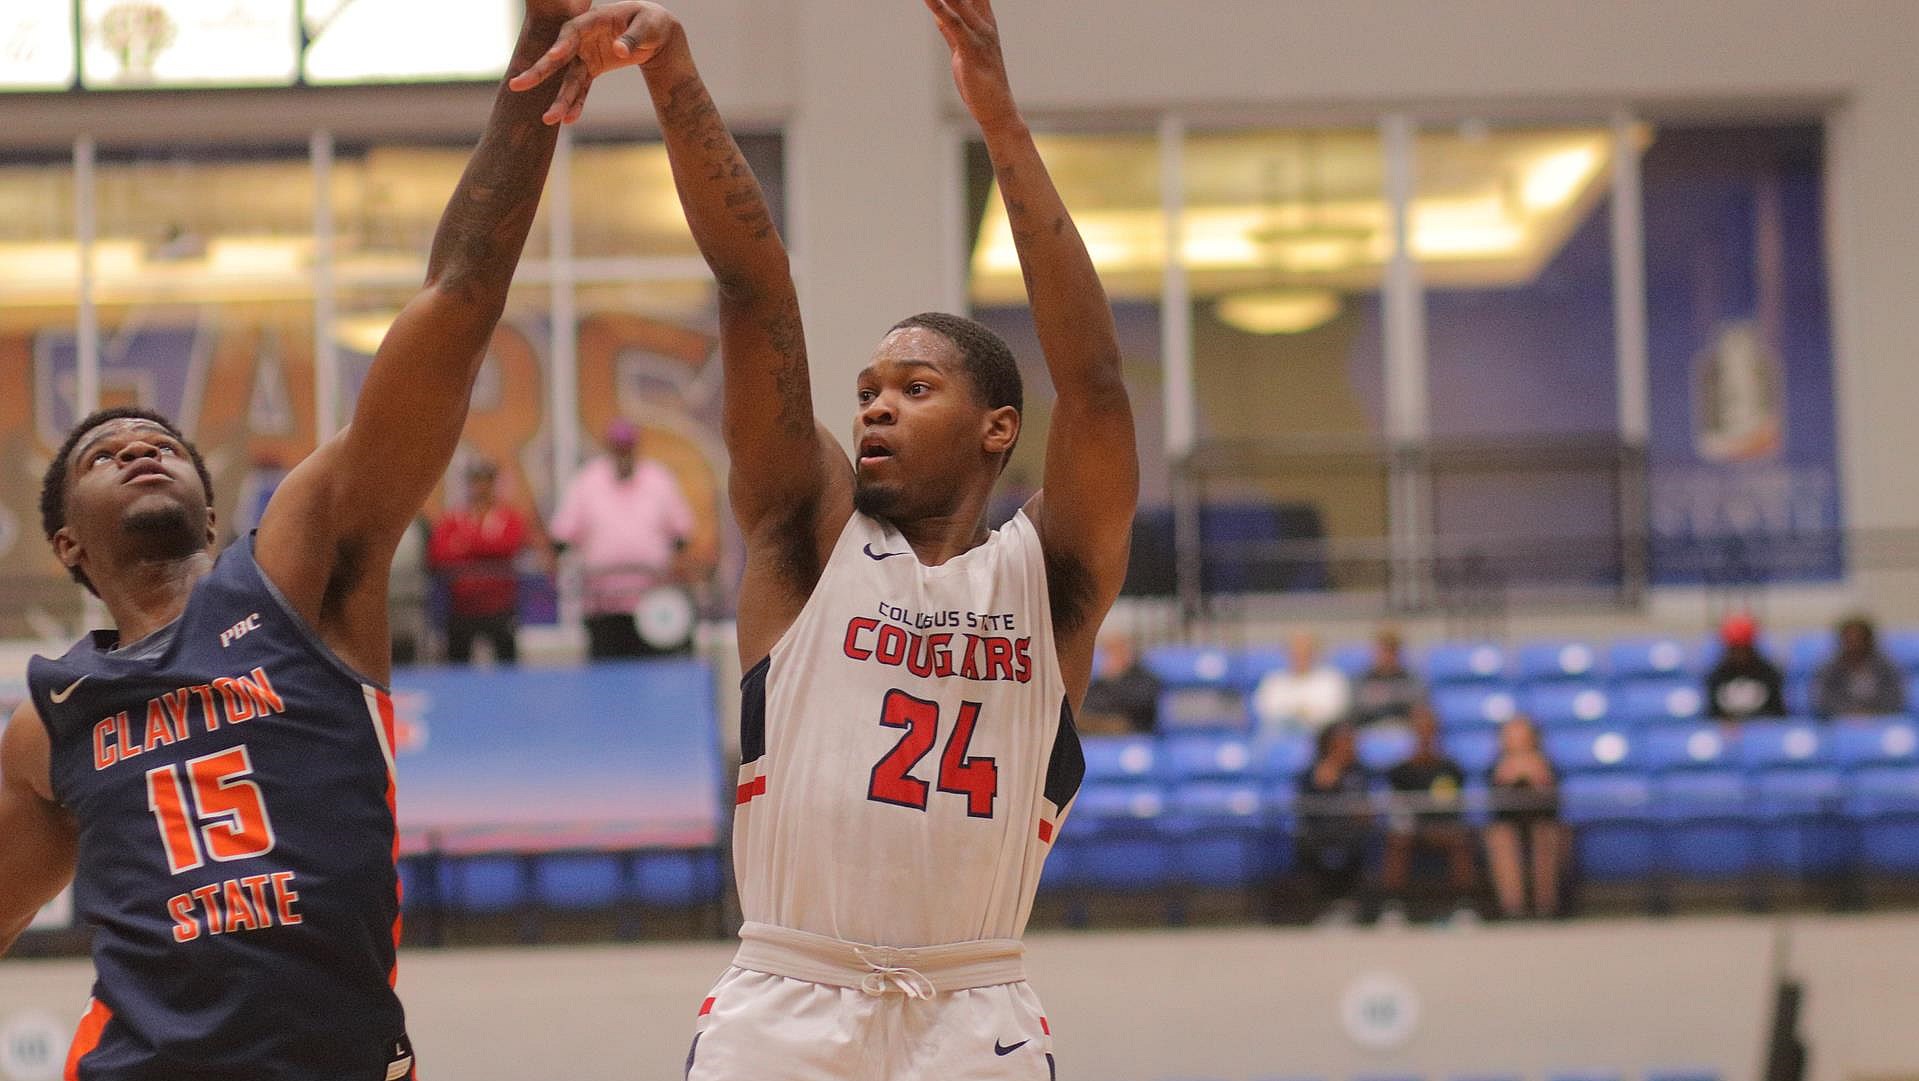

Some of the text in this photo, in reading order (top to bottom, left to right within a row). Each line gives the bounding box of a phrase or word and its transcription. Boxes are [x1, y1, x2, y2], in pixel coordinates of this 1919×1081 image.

[220, 612, 262, 648] PBC
[843, 616, 1032, 683] COUGARS
[92, 666, 286, 771] CLAYTON
[867, 687, 998, 819] 24
[146, 744, 276, 875] 15
[167, 871, 303, 943] STATE
